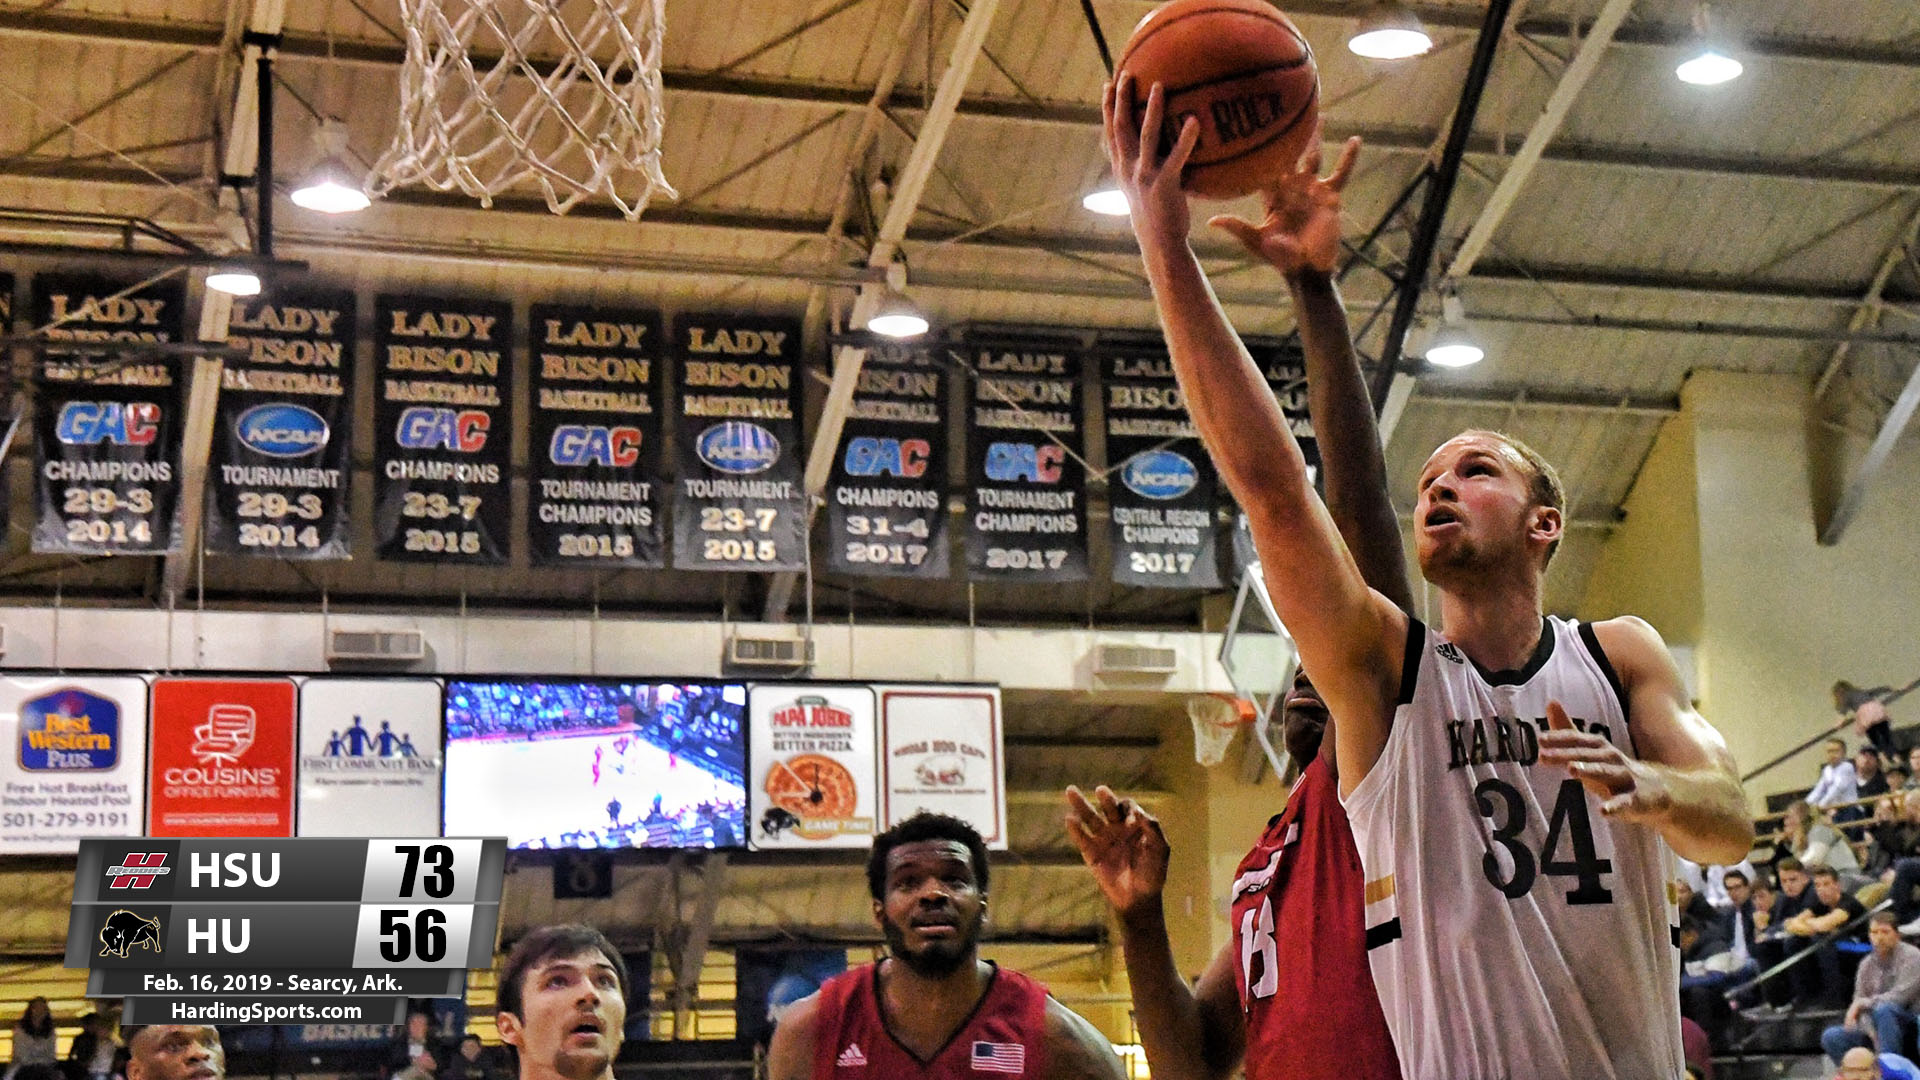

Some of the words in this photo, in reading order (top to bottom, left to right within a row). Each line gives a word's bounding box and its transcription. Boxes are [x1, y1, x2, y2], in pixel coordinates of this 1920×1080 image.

[49, 294, 165, 325] LADY
[229, 303, 340, 335] LADY
[392, 310, 496, 341] LADY
[544, 319, 647, 349] LADY
[688, 327, 787, 357] LADY
[387, 345, 499, 377] BISON
[540, 354, 650, 383] BISON
[684, 361, 792, 390] BISON
[857, 368, 938, 398] ISON
[384, 380, 500, 406] BASKETBALL
[539, 388, 652, 413] BASKETBALL
[976, 379, 1072, 405] BISON
[1110, 386, 1186, 411] BISO
[684, 395, 793, 420] BASKETBALL
[56, 401, 162, 446] GAC
[396, 407, 491, 452] GAC
[550, 425, 643, 467] GAC
[845, 437, 930, 478] GAC
[44, 461, 172, 482] CHAMPIONS
[221, 465, 340, 489] TOURNAMENT
[385, 460, 499, 484] CHAMPIONS
[63, 488, 154, 514] 29-3
[540, 479, 650, 501] TOURNAMENT
[684, 479, 792, 500] TOURNAMENT
[836, 487, 940, 509] CHAMPIONS
[977, 488, 1075, 510] TOURNAMENT
[237, 492, 323, 520] 29-3
[402, 491, 482, 520] 23-7
[539, 504, 652, 527] CHAMPIONS
[1113, 506, 1163, 526] CENTRAL
[1166, 510, 1210, 528] REGION
[66, 519, 152, 543] 2014
[701, 507, 778, 532] 23-7
[846, 515, 929, 538] 31-4
[975, 511, 1078, 534] CHAMPIONS
[239, 524, 320, 548] 2014
[405, 529, 481, 554] 2015
[558, 534, 634, 558] 2015
[1123, 525, 1199, 545] CHAMPIONS
[703, 539, 777, 562] 2015
[846, 542, 928, 565] 2017
[986, 548, 1068, 570] 2017
[1130, 551, 1196, 574] 2017
[45, 713, 91, 733] Best
[774, 706, 806, 726] PAPA
[28, 730, 111, 750] Western
[774, 741, 815, 752] BETTER
[303, 759, 333, 769] FIRST
[336, 759, 403, 769] COMMUNITY
[6, 782, 35, 793] Free
[67, 782, 128, 793] Breakfast
[3, 813, 128, 827] 501-279-9191
[1474, 778, 1613, 905] 34
